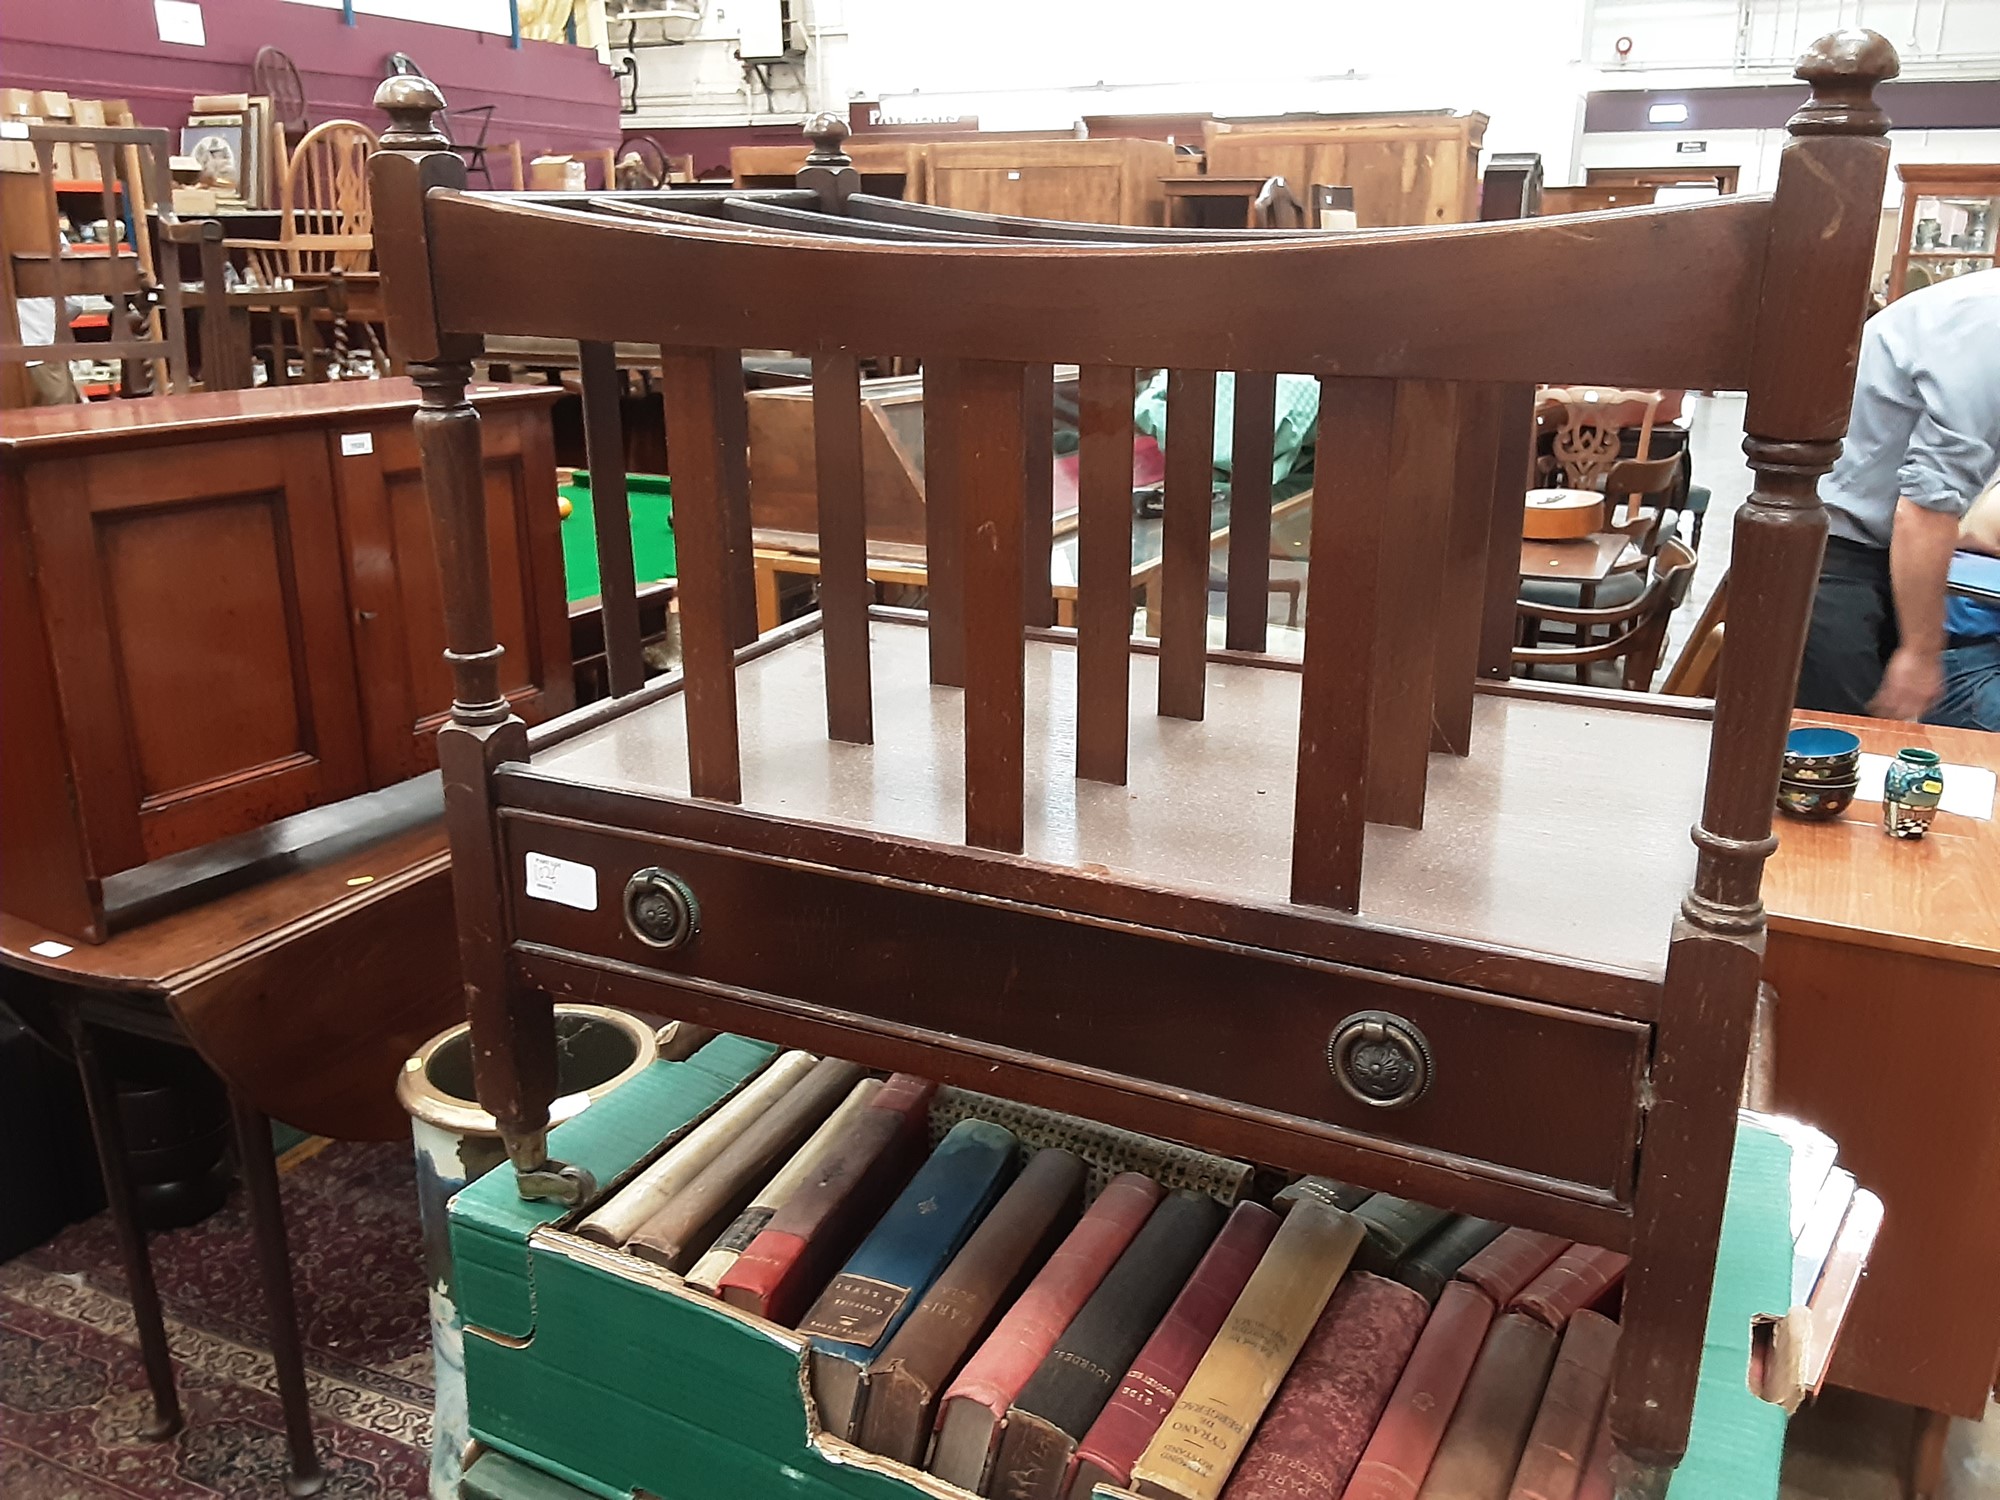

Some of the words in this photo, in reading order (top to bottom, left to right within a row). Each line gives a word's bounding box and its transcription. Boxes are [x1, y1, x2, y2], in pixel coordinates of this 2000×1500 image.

[1179, 1401, 1244, 1434] BERGERAC
[1199, 1416, 1215, 1428] DE
[1172, 1421, 1227, 1450] CYRANO
[1257, 1468, 1315, 1497] PARIS
